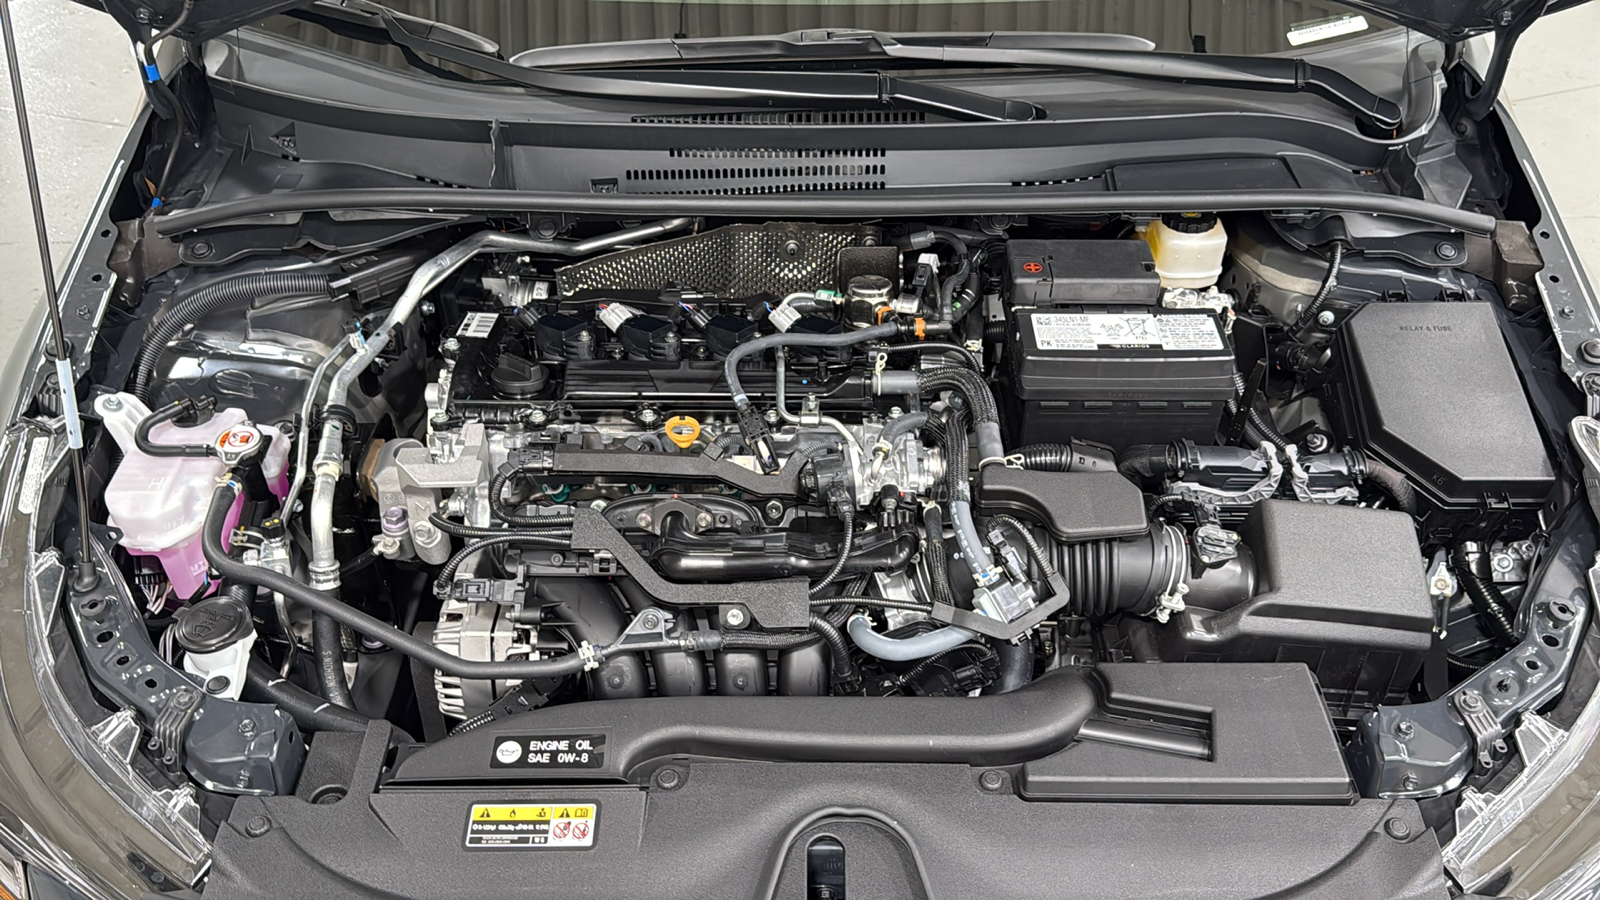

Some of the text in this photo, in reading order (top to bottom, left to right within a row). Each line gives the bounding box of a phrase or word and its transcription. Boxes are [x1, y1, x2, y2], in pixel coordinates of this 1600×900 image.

[529, 740, 593, 751] ENGINE OIL
[527, 753, 589, 763] SAE 0W-8
